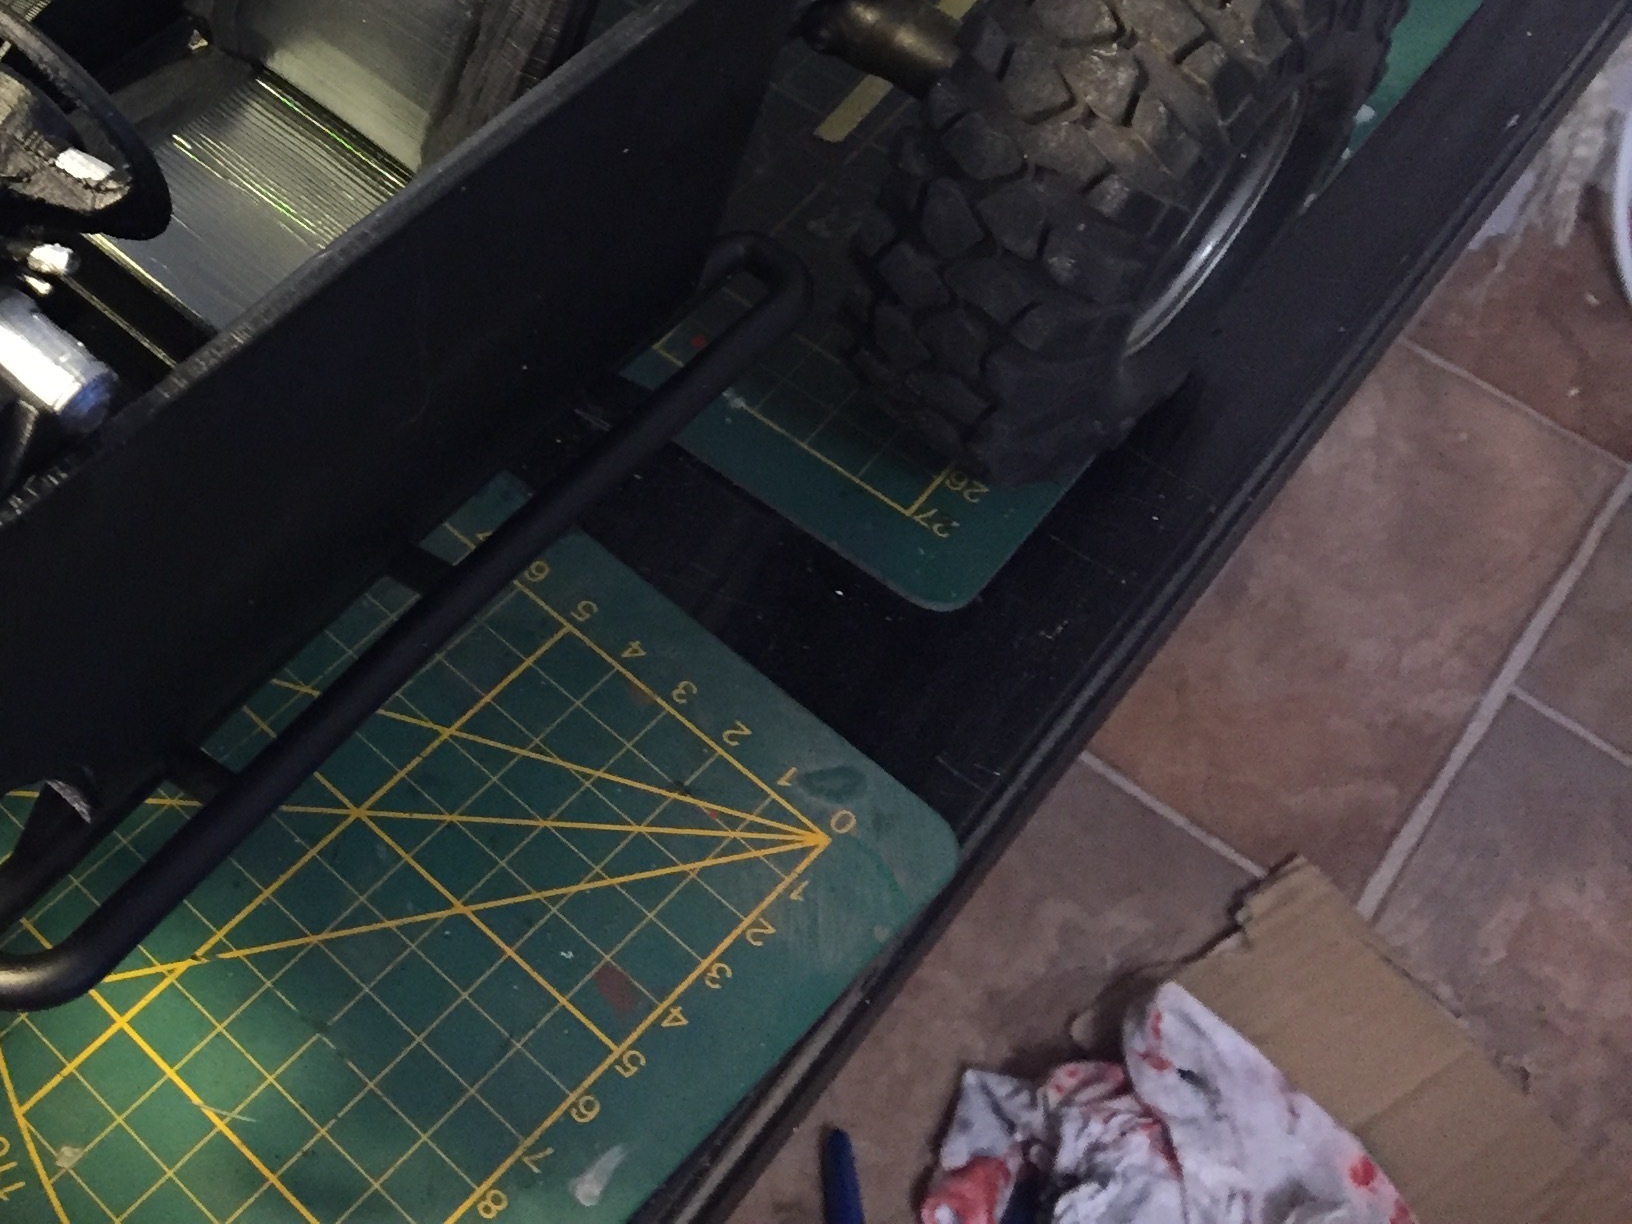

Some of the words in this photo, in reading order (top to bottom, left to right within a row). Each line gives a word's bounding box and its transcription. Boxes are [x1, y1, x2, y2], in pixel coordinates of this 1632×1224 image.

[571, 600, 598, 622] 5
[621, 640, 646, 658] 4
[672, 680, 698, 704] 3
[722, 720, 752, 746] 2
[777, 766, 797, 786] 1
[830, 810, 857, 834] 0
[789, 880, 809, 901] 1
[745, 917, 776, 946] 2
[704, 963, 732, 989] 3
[661, 1006, 689, 1027] 4
[614, 1050, 646, 1078] 5
[570, 1095, 600, 1123] 6
[522, 1147, 554, 1173] 7
[477, 1189, 508, 1219] 8
